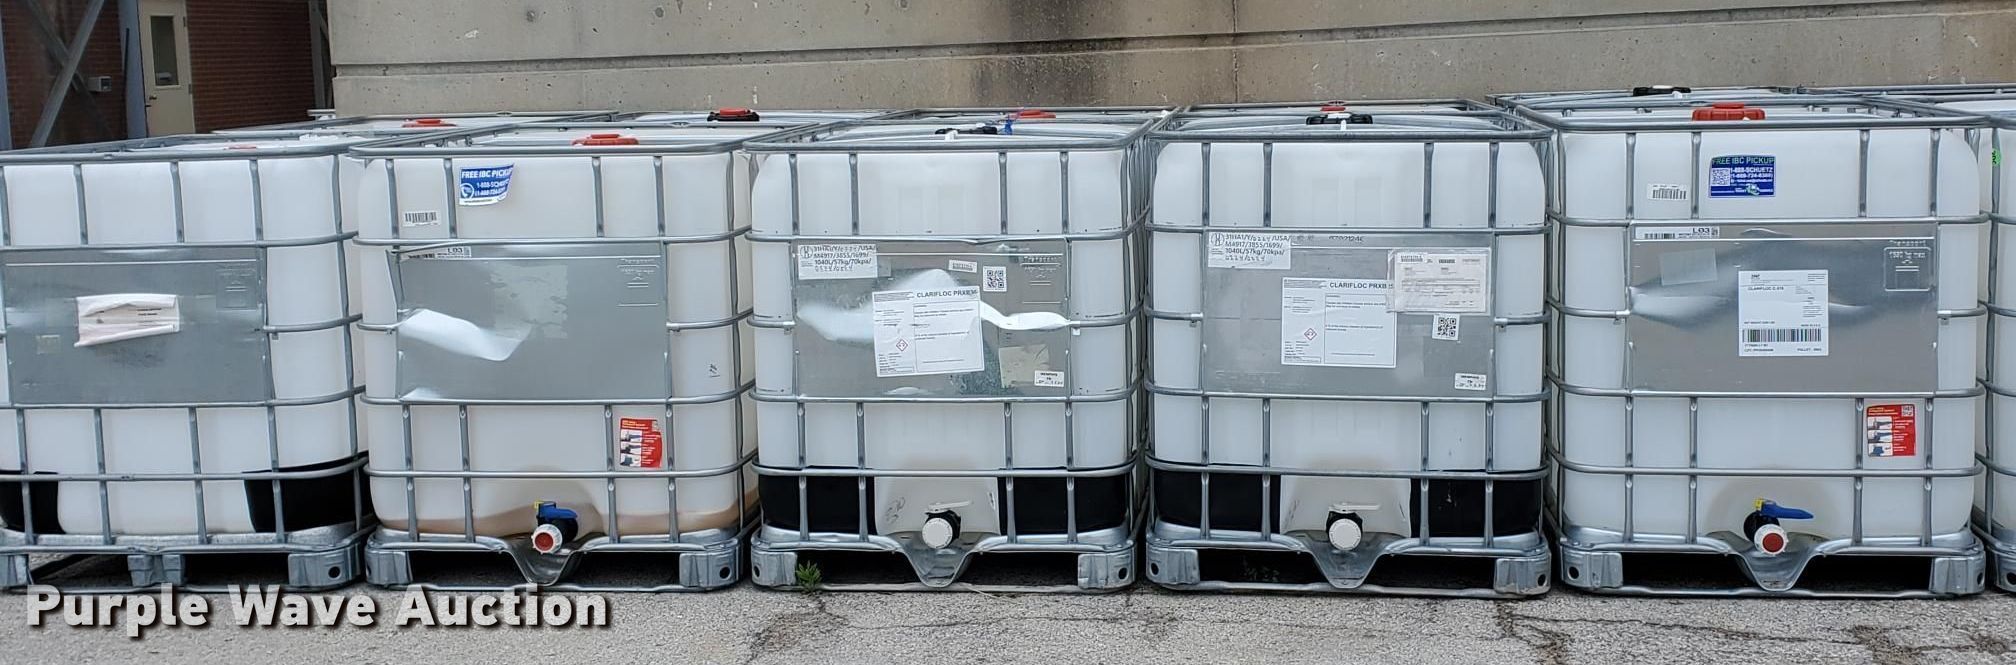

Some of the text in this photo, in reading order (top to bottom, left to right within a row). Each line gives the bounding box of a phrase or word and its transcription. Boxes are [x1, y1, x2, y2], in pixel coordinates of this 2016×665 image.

[1712, 157, 1731, 165] FREE
[1746, 156, 1775, 164] PICKUP
[461, 170, 479, 179] FREE
[479, 170, 492, 178] IBC
[916, 290, 952, 298] CLARIFLOC
